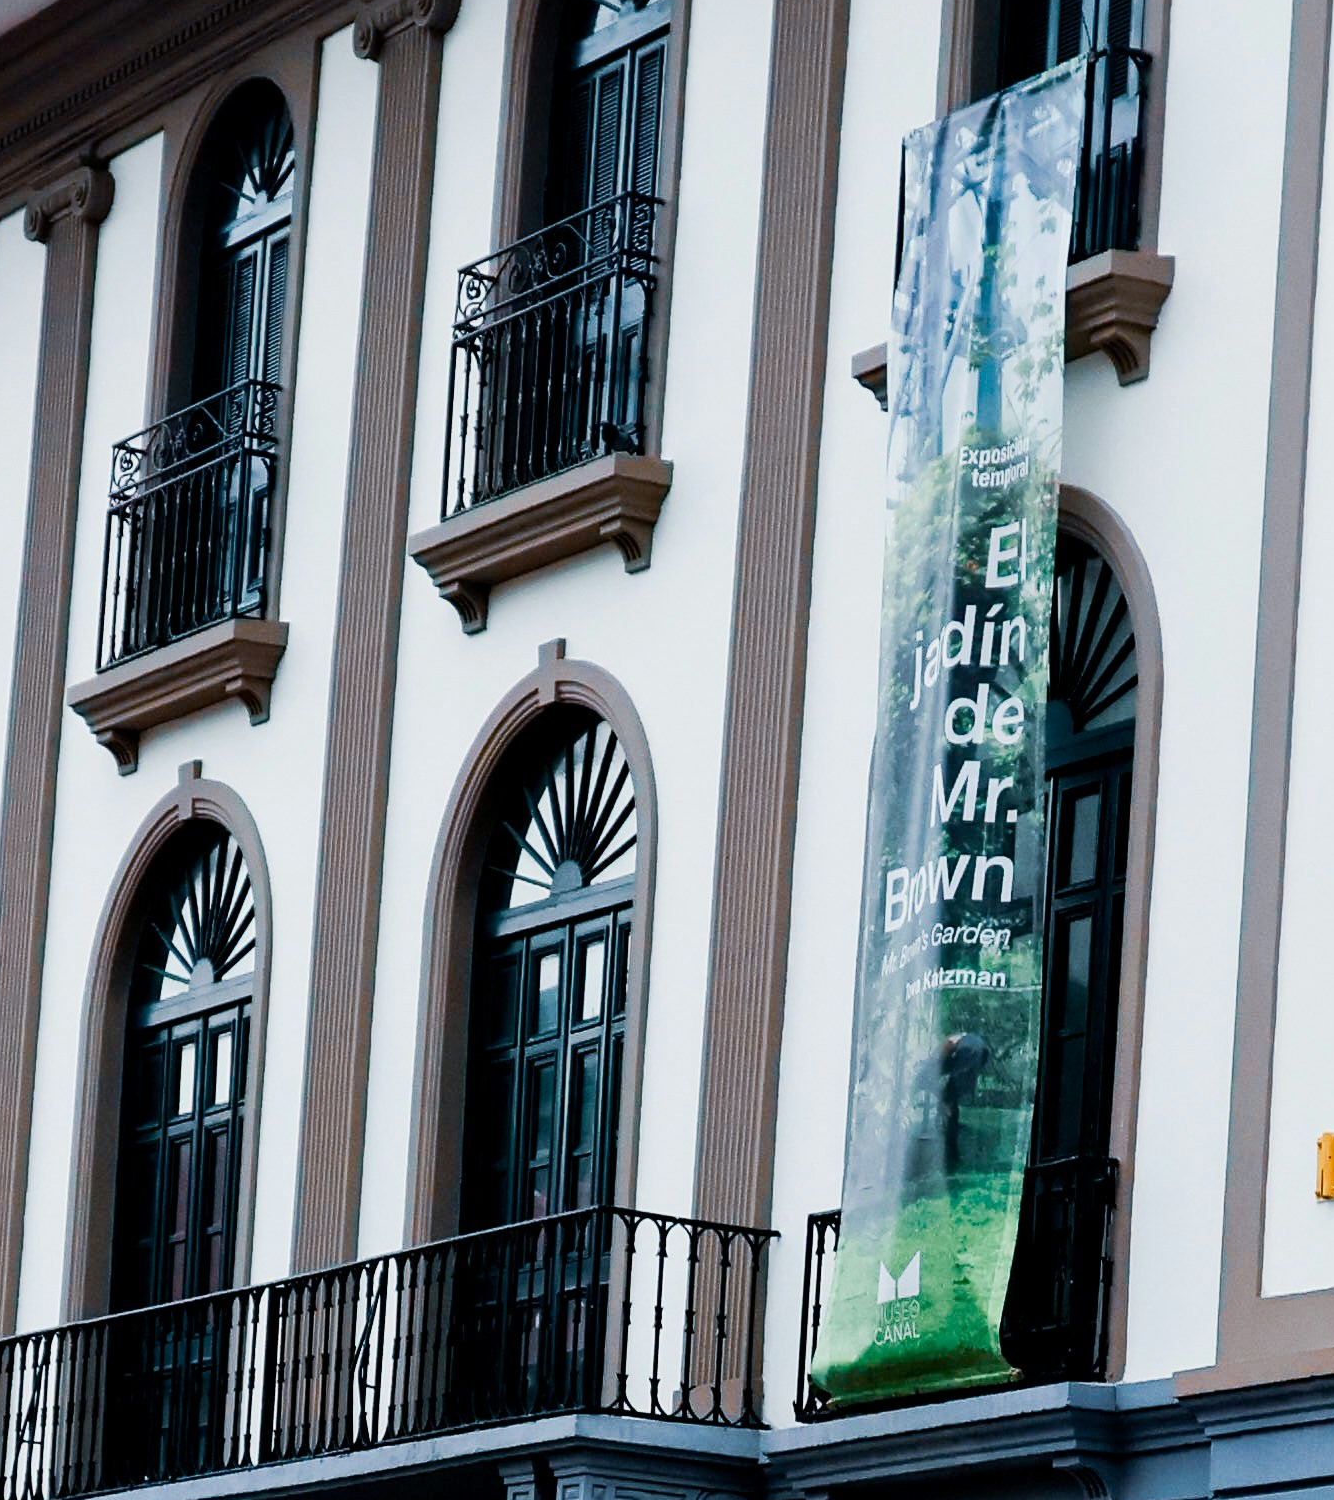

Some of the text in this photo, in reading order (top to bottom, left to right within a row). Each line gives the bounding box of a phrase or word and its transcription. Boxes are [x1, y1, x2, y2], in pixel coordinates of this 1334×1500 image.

[971, 455, 1029, 490] temporal
[985, 517, 1027, 589] El
[910, 602, 1027, 710] jadín
[944, 682, 1025, 745] de
[929, 759, 1018, 829] Mr.
[883, 853, 1015, 933] Brown
[930, 921, 1012, 950] Garden
[922, 966, 1008, 991] Katzman
[874, 1320, 921, 1346] CANAL
